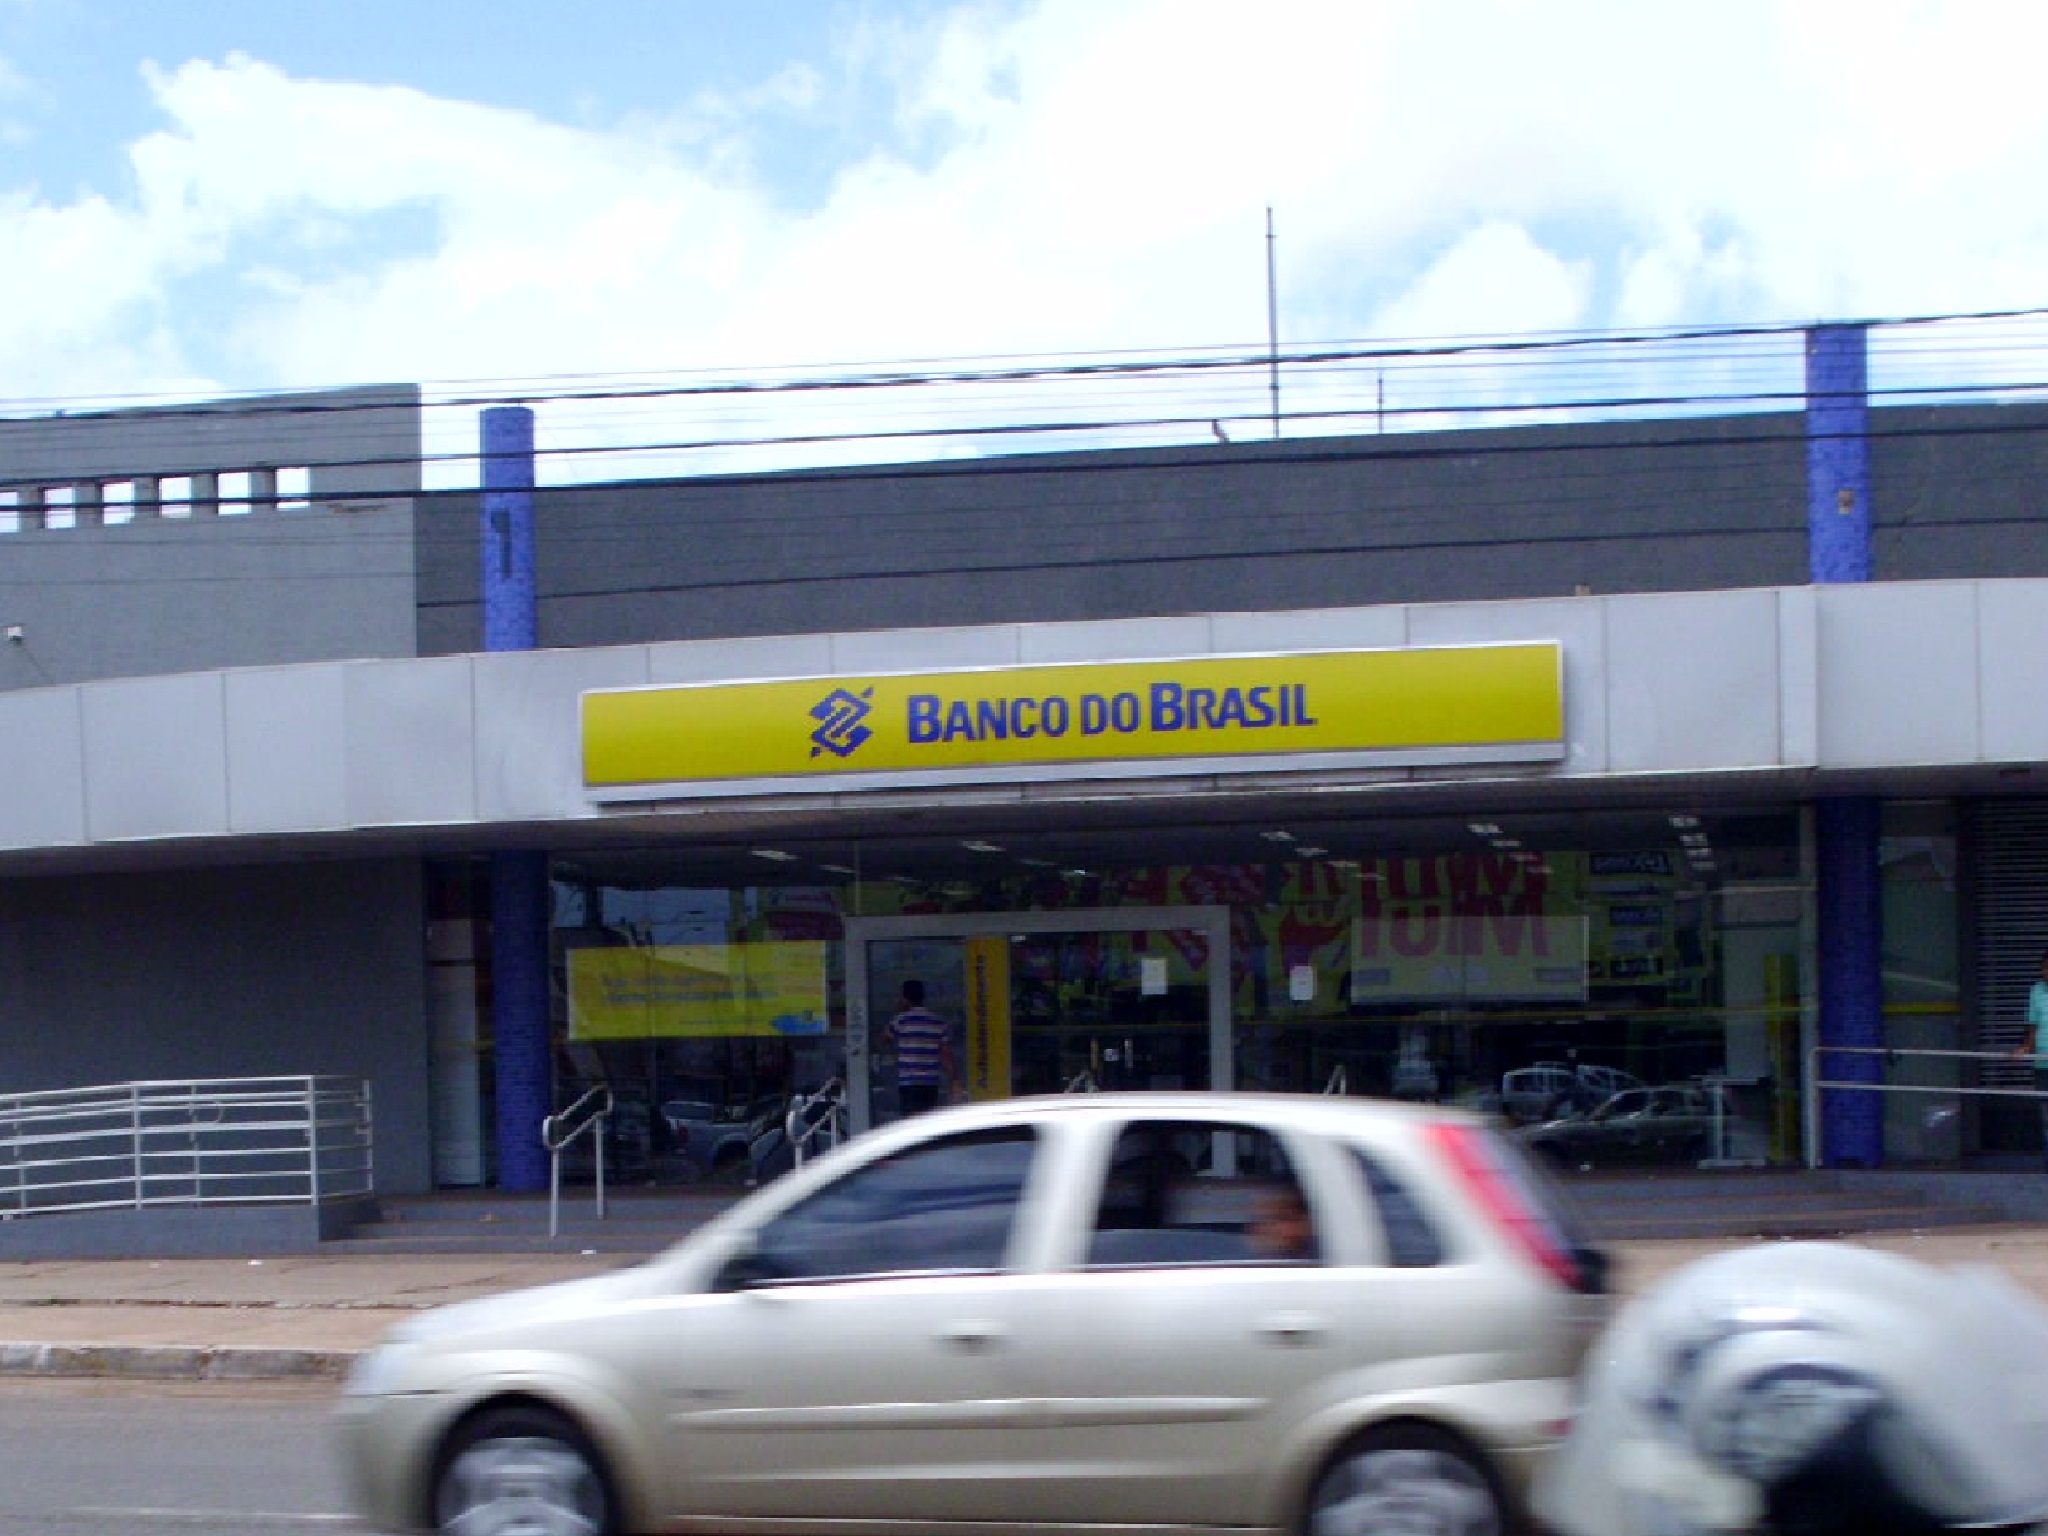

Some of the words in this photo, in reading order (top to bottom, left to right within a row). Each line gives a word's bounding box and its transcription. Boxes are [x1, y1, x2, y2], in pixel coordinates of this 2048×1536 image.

[908, 694, 1069, 743] BANCO
[1080, 692, 1140, 735] DO
[1150, 682, 1319, 732] BRASIL
